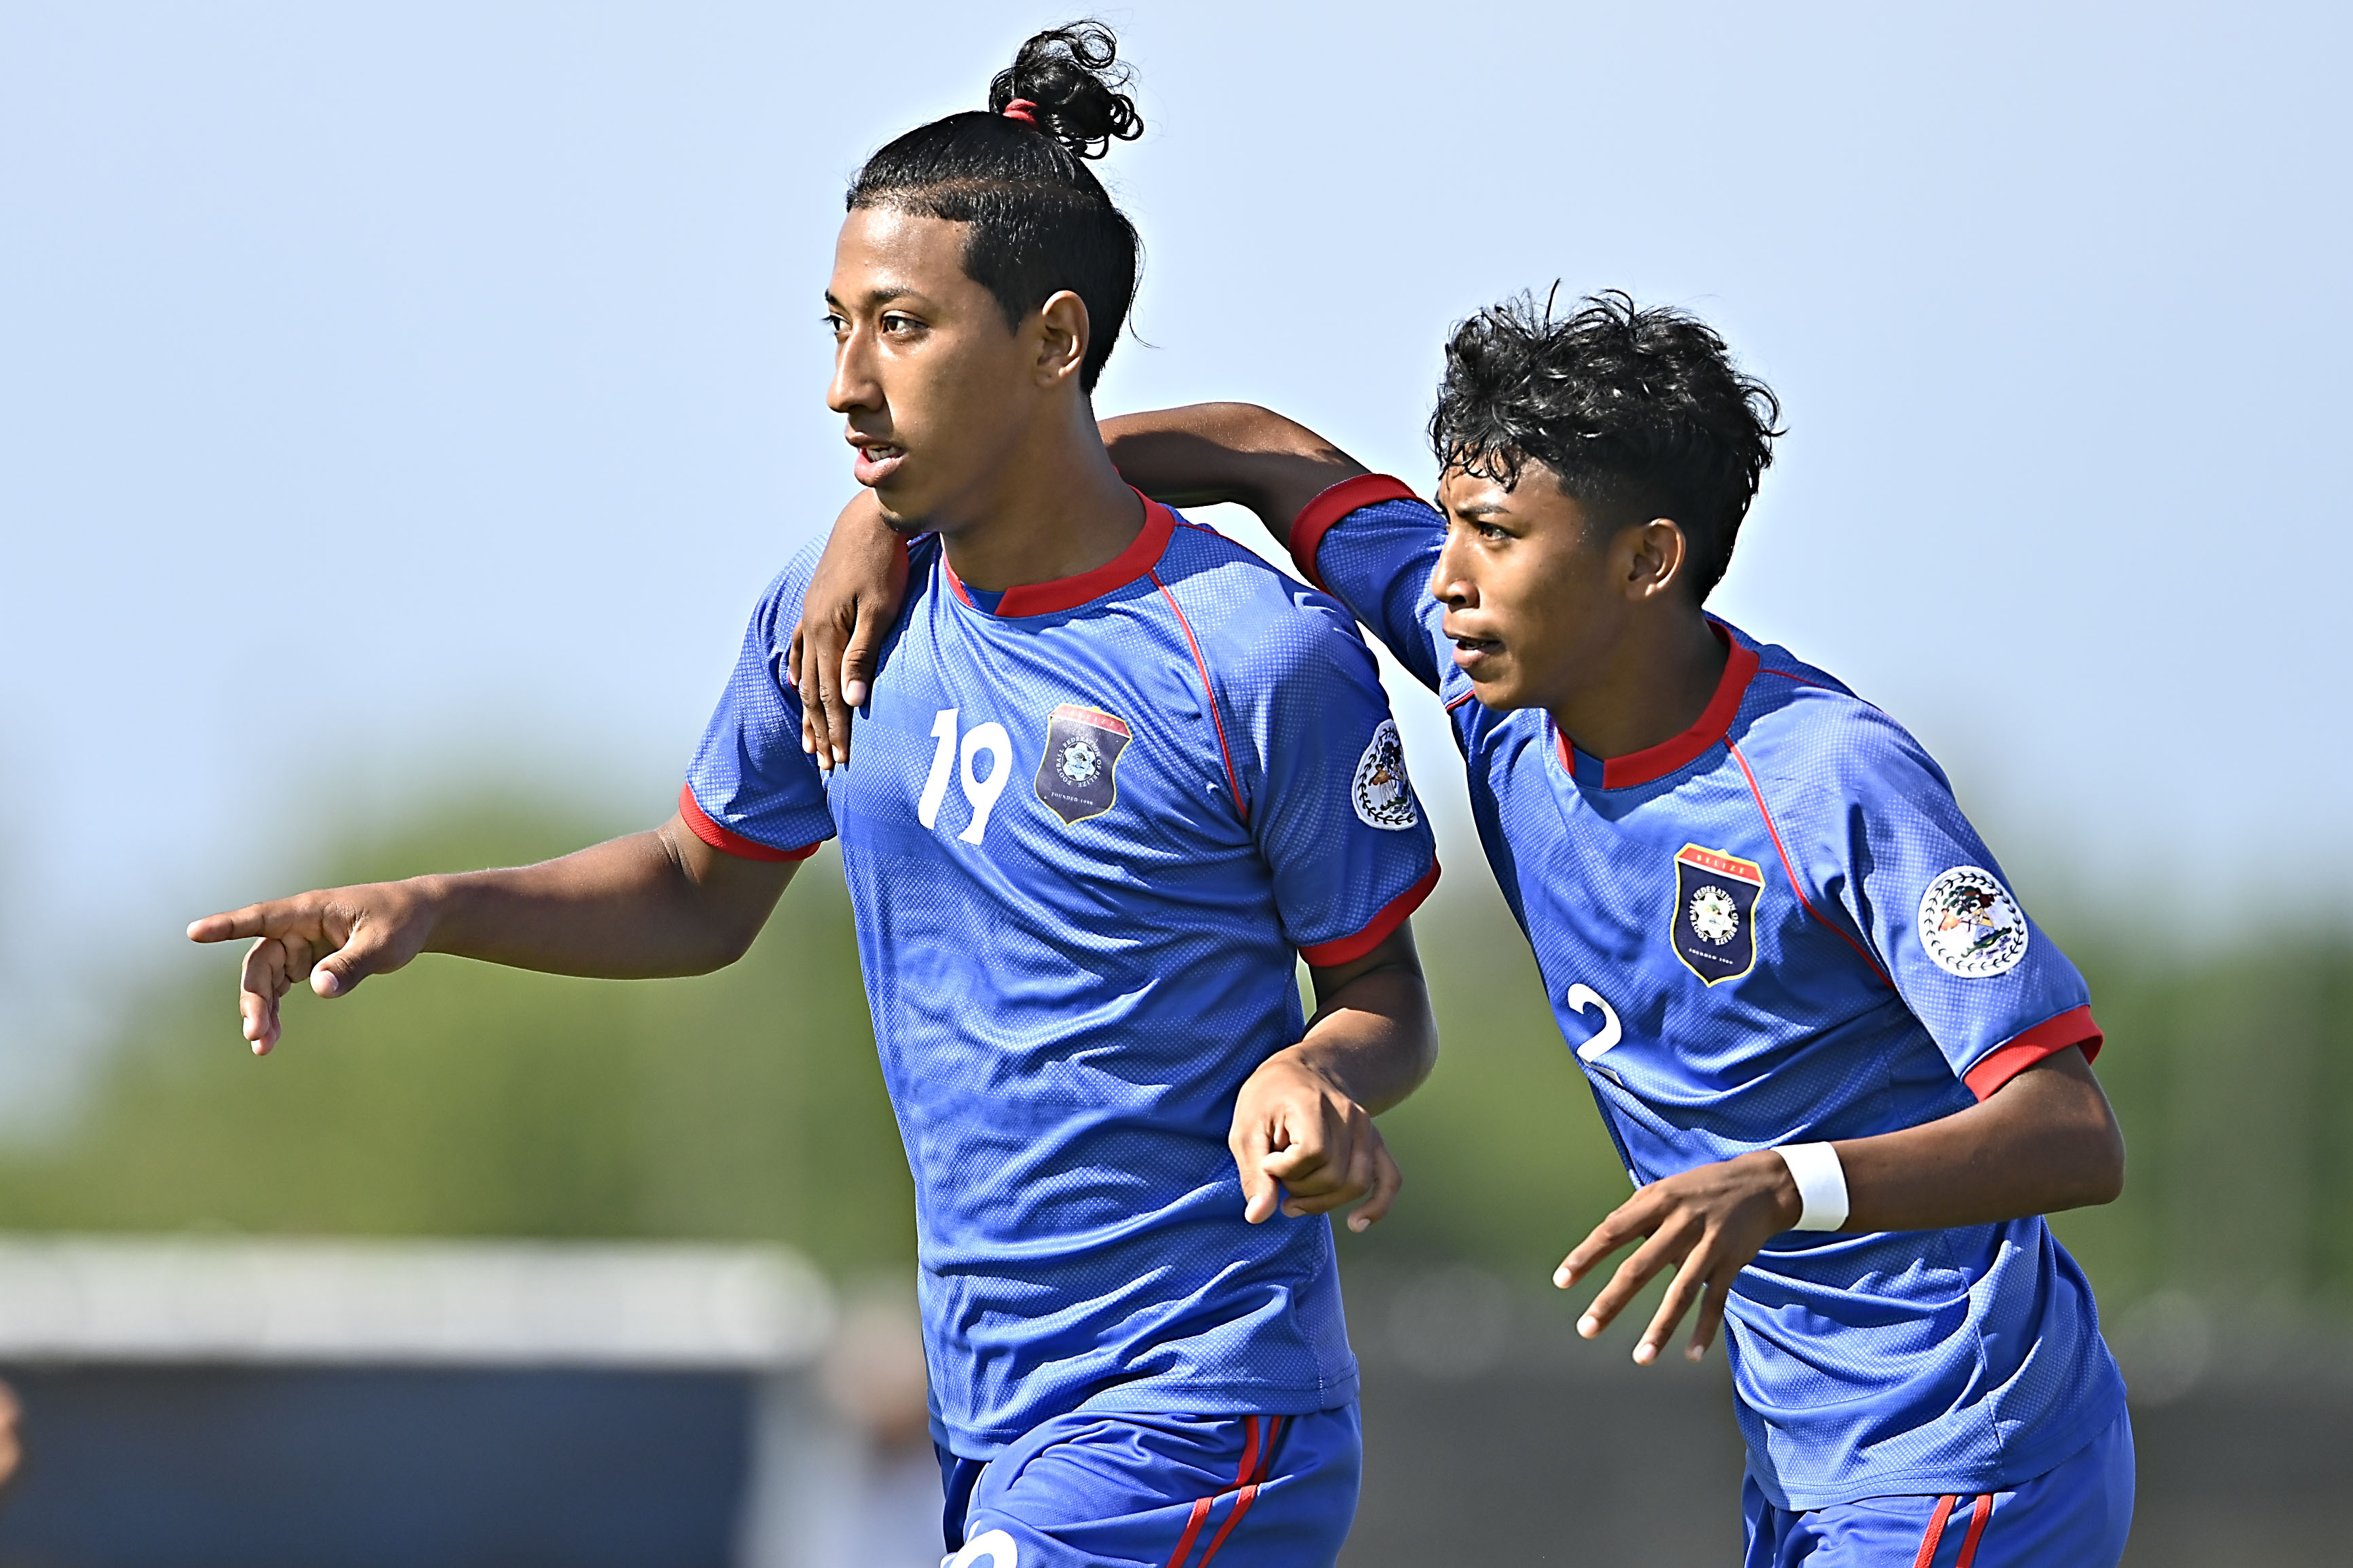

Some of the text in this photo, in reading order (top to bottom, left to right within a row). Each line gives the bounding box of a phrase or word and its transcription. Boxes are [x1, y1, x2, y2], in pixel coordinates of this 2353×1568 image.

[918, 708, 1013, 845] 19
[1056, 736, 1101, 788] FOOTBALL FEDERATION OF BELIZE
[1051, 792, 1078, 802] FOUNDED
[1697, 854, 1744, 874] BELIZE
[1693, 886, 1737, 910] FEDERATION
[1568, 983, 1623, 1087] 2
